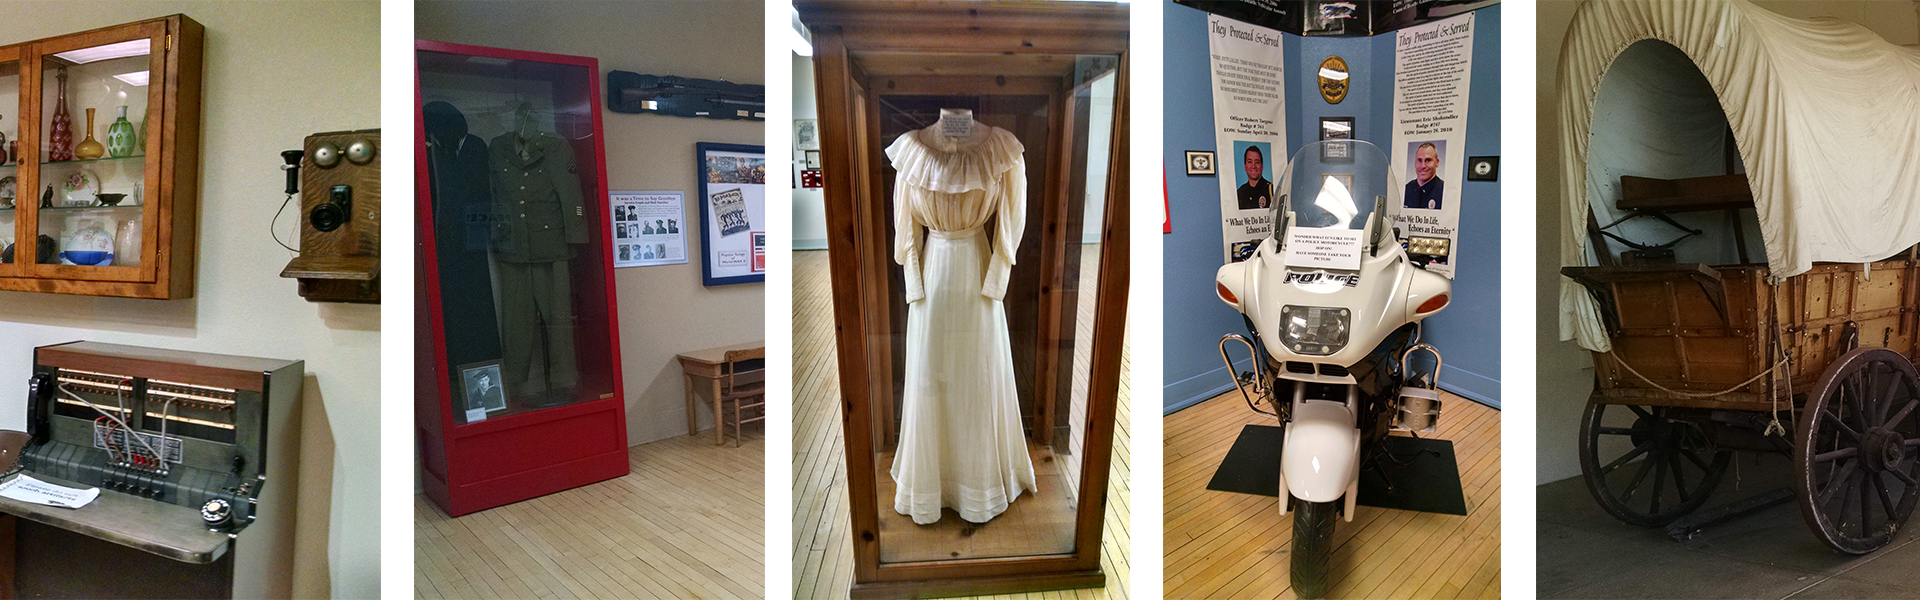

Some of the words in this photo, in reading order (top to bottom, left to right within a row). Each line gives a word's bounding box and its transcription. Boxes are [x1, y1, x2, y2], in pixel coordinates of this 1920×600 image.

[1211, 20, 1226, 38] They
[1230, 25, 1254, 42] Protected
[1263, 34, 1279, 47] Served
[1399, 33, 1412, 48] They
[1414, 24, 1440, 43] Protected
[1449, 17, 1471, 36] Served
[1229, 217, 1244, 227] What
[1244, 216, 1251, 226] We
[1251, 216, 1259, 225] Do
[1407, 215, 1415, 224] We
[1415, 215, 1424, 224] Do
[1246, 225, 1260, 235] Echoes
[1408, 224, 1424, 234] Echoes
[1430, 226, 1451, 238] Eternity
